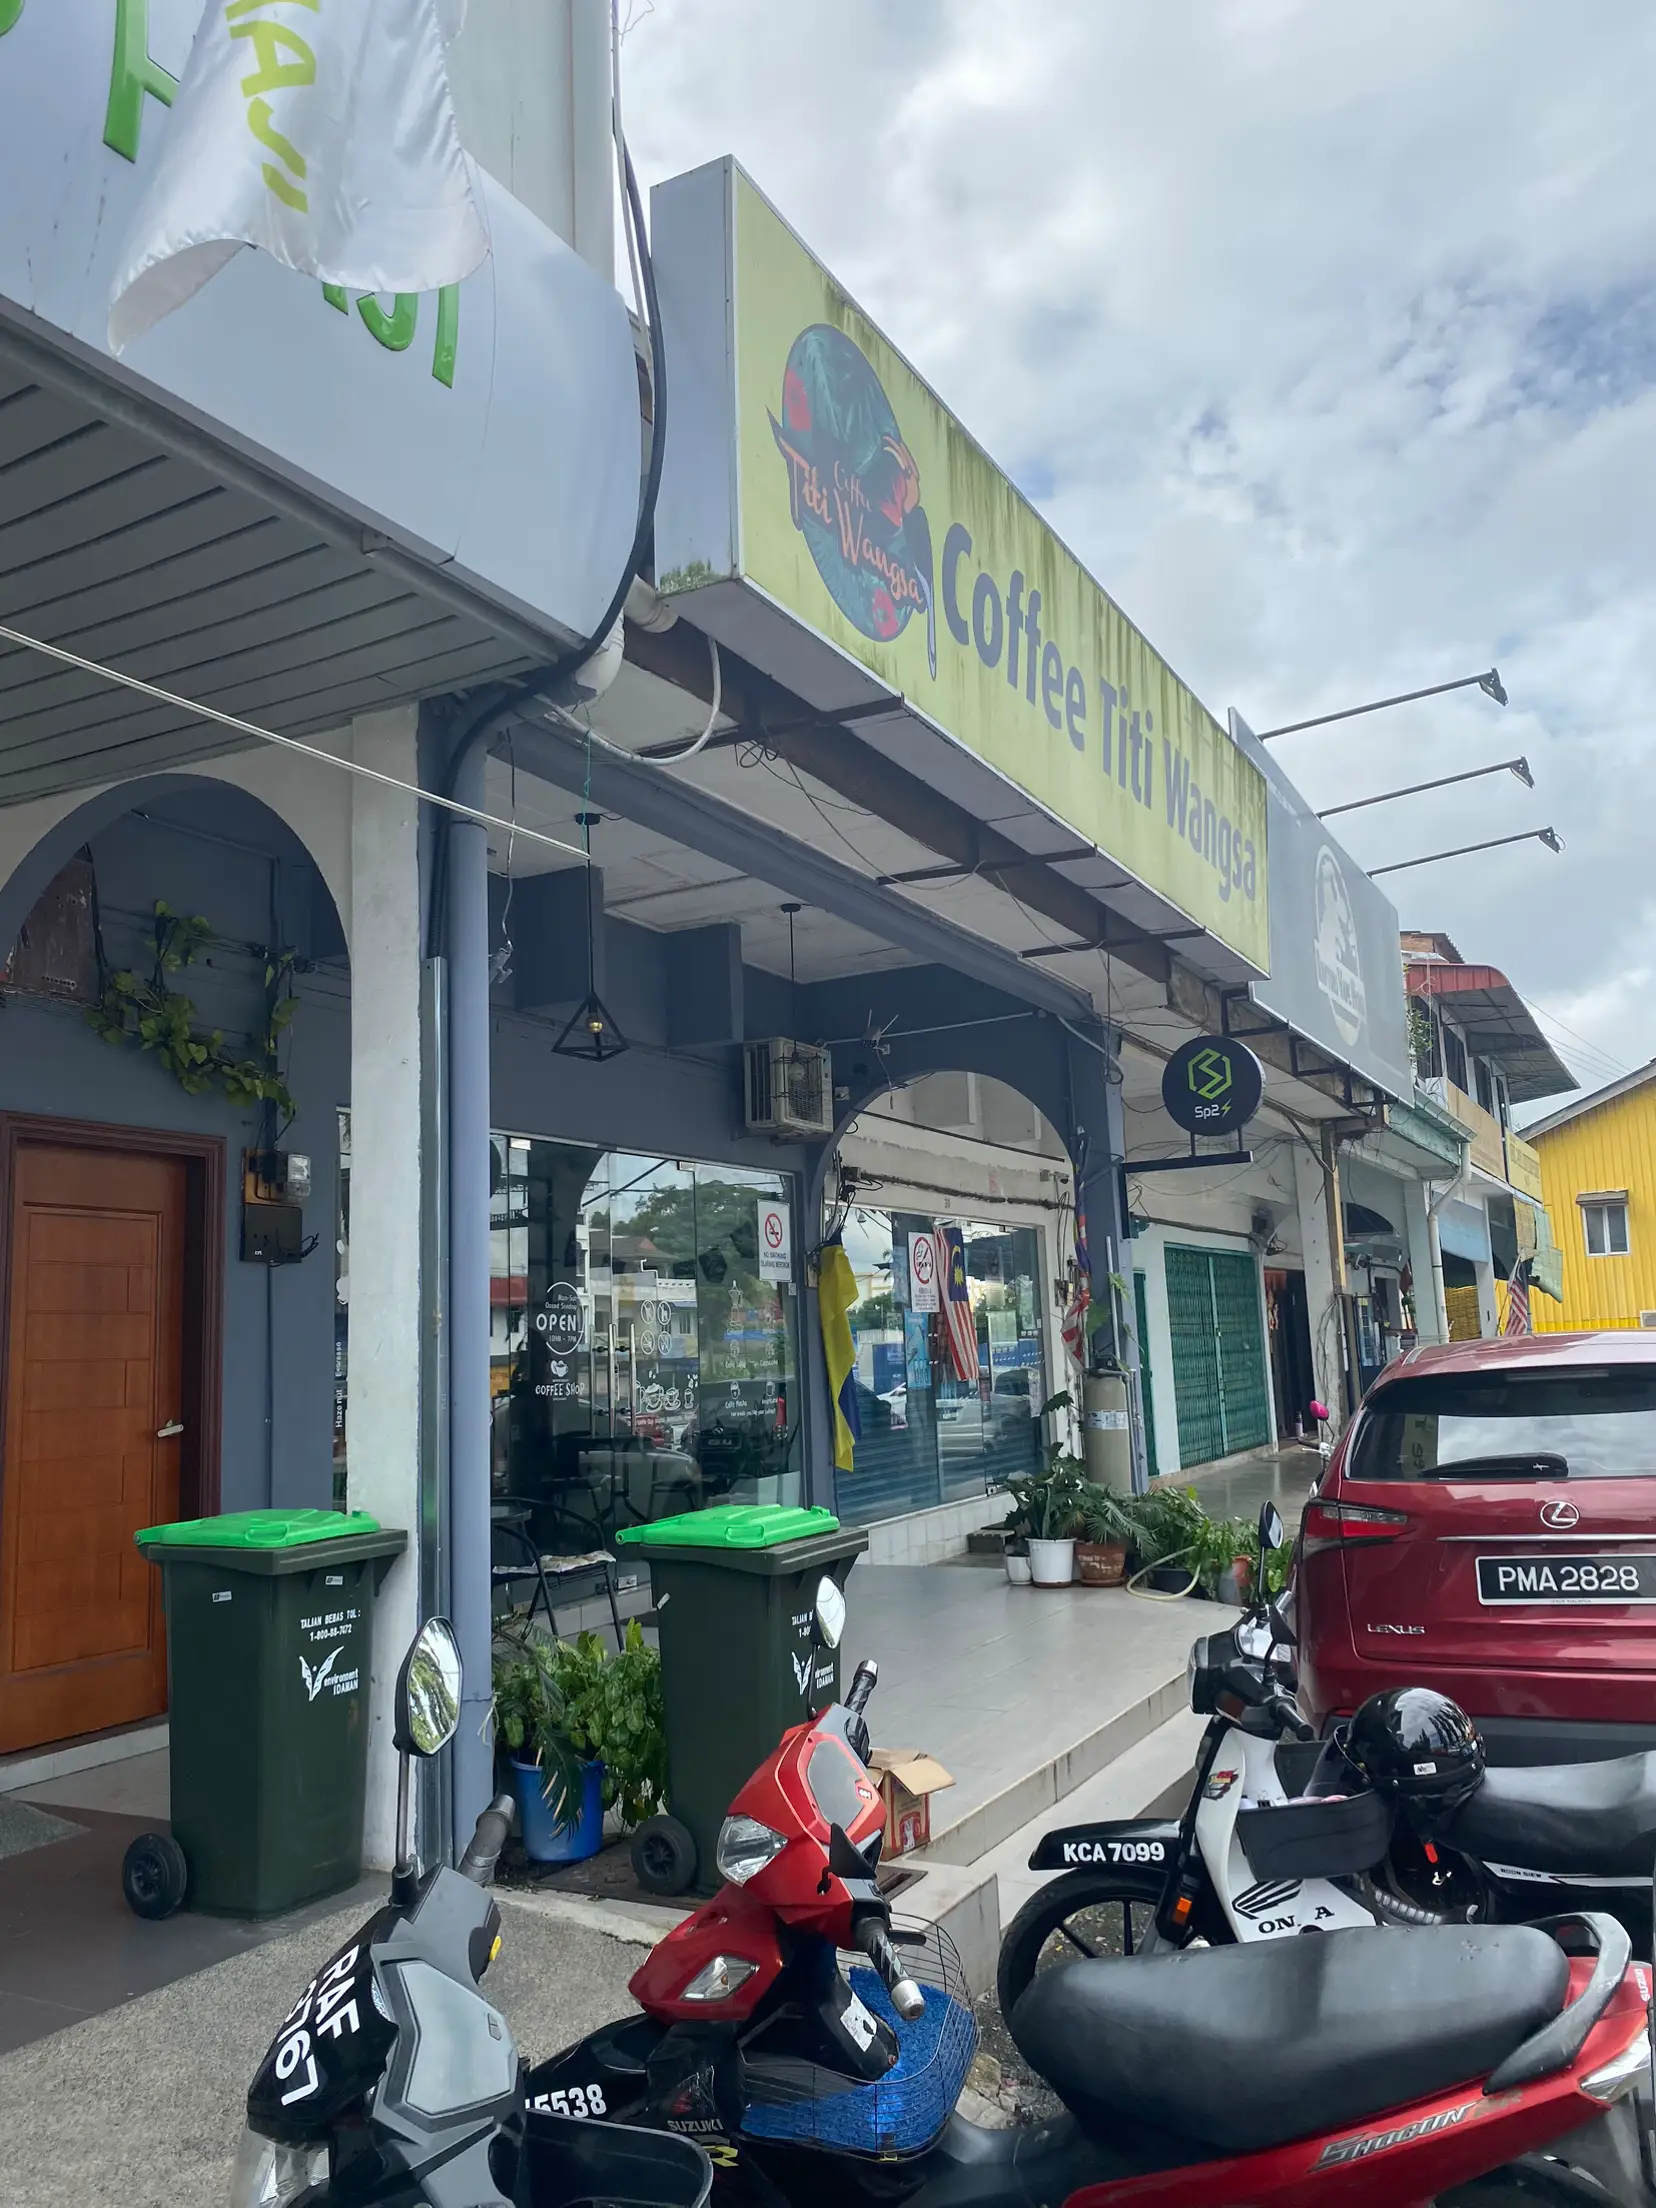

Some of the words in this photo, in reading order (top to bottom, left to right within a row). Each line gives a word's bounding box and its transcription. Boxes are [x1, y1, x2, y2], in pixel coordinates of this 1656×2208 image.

[778, 436, 832, 524] Titi
[833, 488, 922, 605] Wangsa
[942, 523, 1086, 751] Coffee
[1100, 676, 1152, 810] Titi
[1163, 739, 1256, 902] Wangsa
[1194, 1104, 1220, 1119] Sp2
[536, 1313, 577, 1332] OPEN
[535, 1383, 564, 1396] COFFEE
[565, 1382, 585, 1396] SHOP
[301, 1616, 322, 1629] TALIAN
[325, 1612, 344, 1625] BEBAS
[1367, 1623, 1425, 1635] LEXUS
[333, 1679, 359, 1695] IDAMAN
[1063, 1843, 1106, 1862] KCA
[1107, 1842, 1165, 1862] 7099
[316, 1945, 360, 2038] RAF
[275, 1980, 319, 2106] 3767
[667, 2119, 724, 2133] SUZUKI
